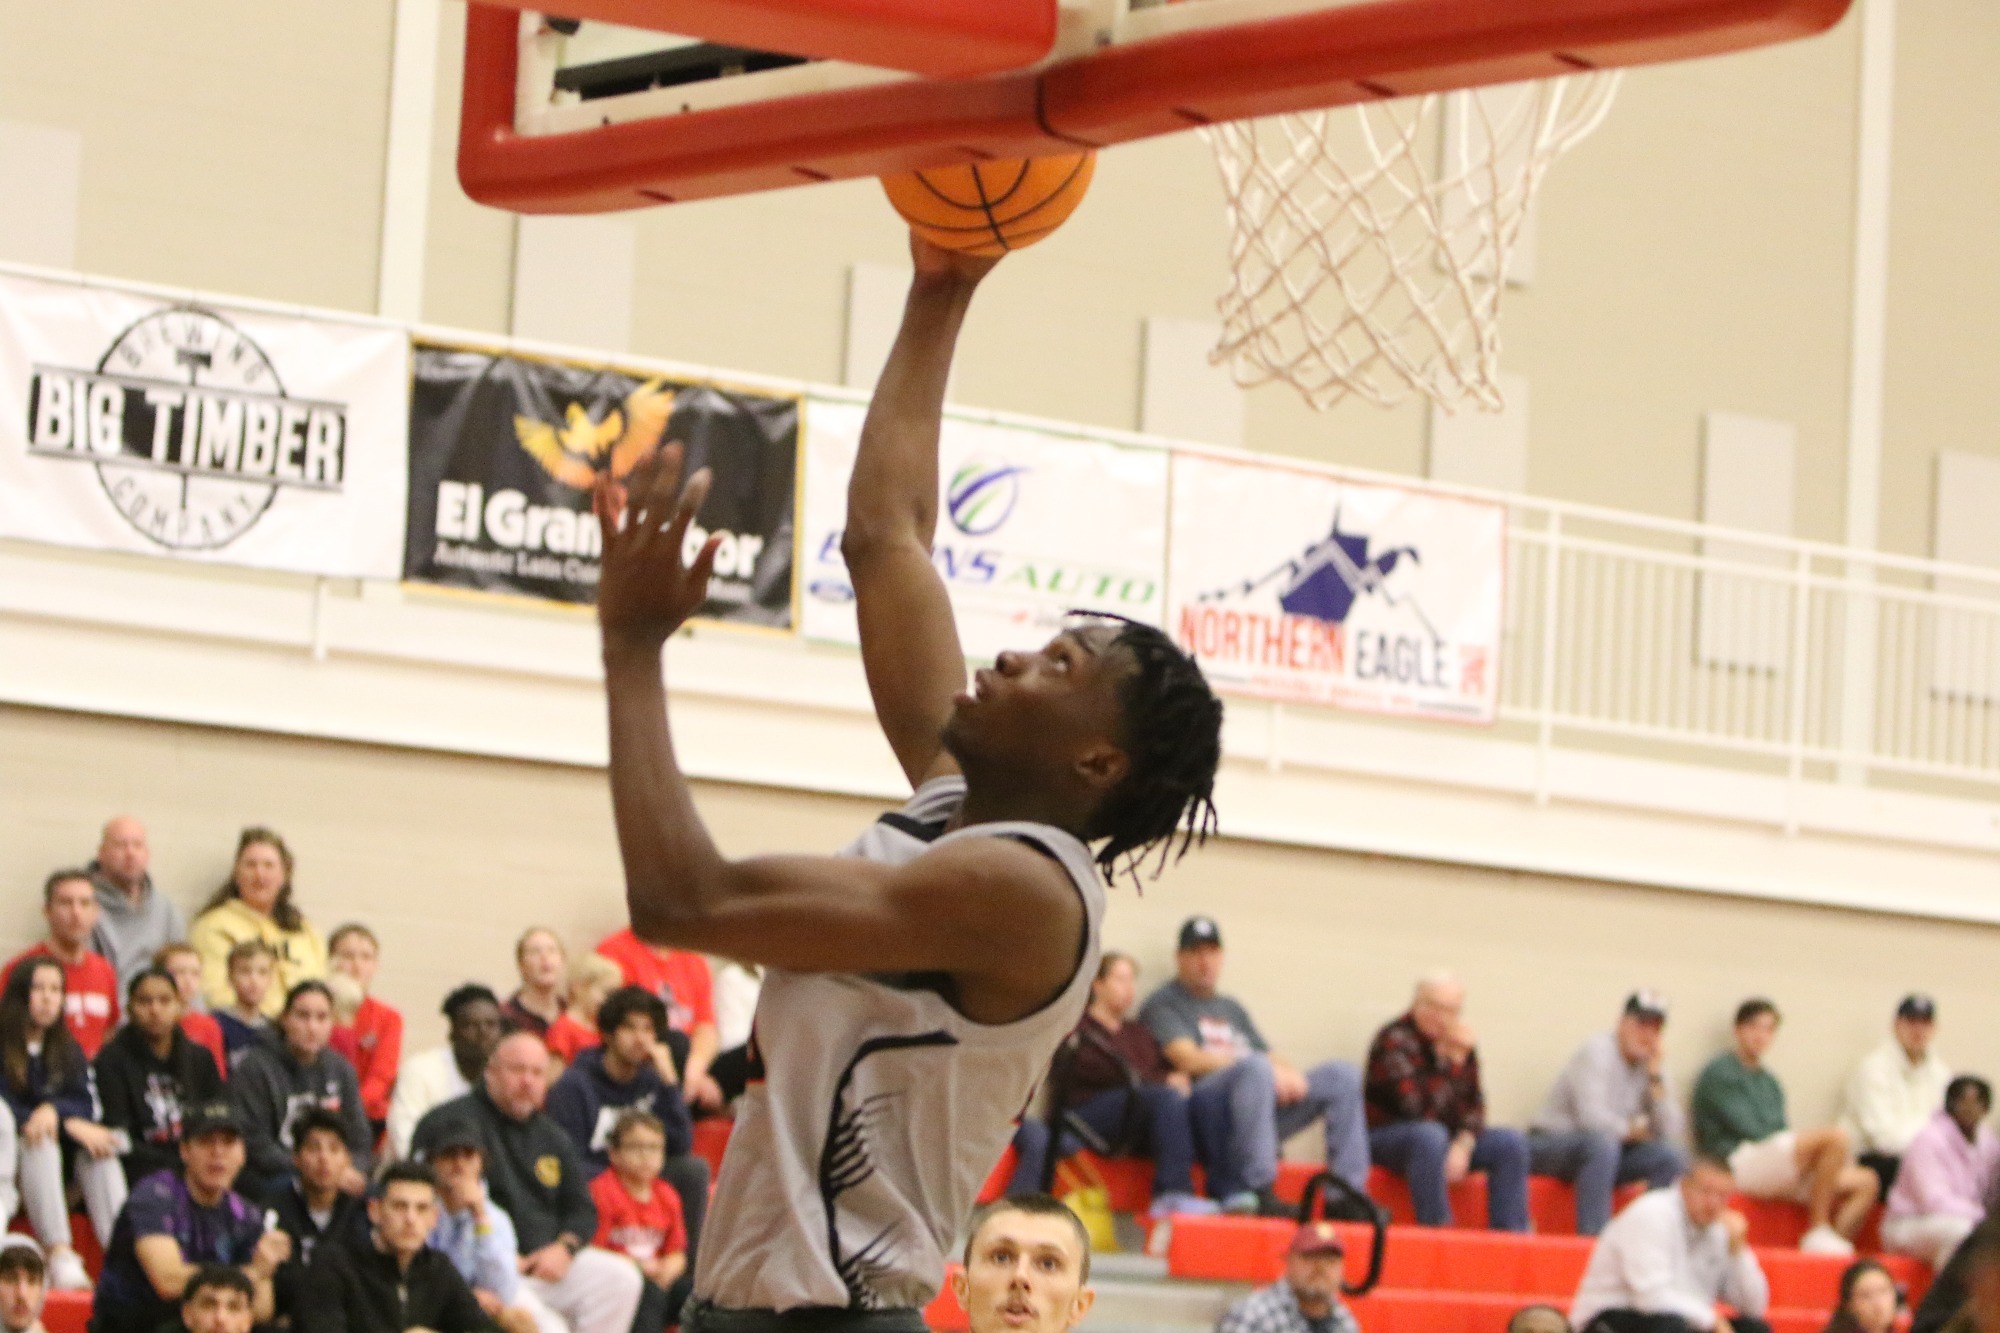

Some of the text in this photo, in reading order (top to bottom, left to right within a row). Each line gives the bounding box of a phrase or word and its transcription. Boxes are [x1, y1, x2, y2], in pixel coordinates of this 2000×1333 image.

[118, 318, 267, 384] BREWING
[34, 375, 344, 484] BIG TIMBER
[114, 477, 254, 540] COMPANY
[435, 480, 484, 541] El
[484, 489, 604, 558] Gran
[1009, 563, 1156, 603] AUTO
[1180, 605, 1450, 689] NORTHERN EAGLE
